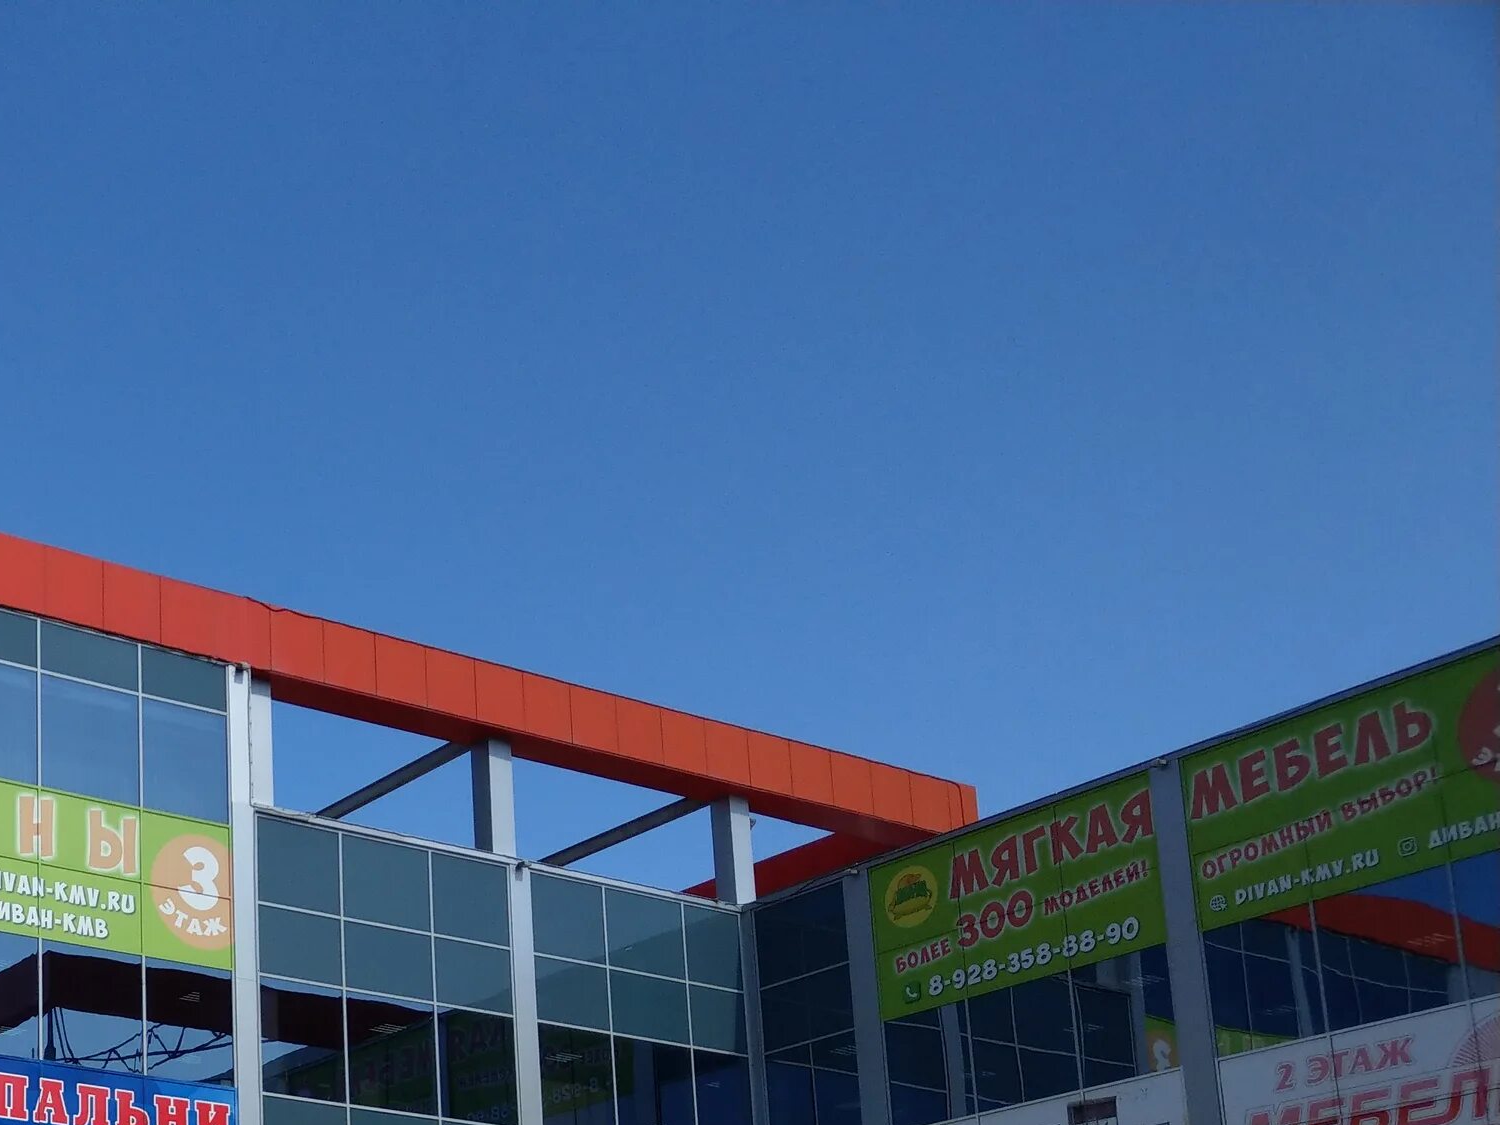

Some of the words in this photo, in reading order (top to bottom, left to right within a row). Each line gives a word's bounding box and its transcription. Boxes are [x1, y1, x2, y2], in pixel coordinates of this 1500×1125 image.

[1190, 701, 1433, 820] МЕБЕЛЬ
[949, 789, 1154, 899] МЯГКАЯ
[1201, 810, 1333, 880] ОГРОМНЫЙ
[1340, 766, 1438, 822] ВЫБОР!
[182, 846, 220, 910] 3
[1235, 848, 1381, 905] DIVAN-KMV.RU
[158, 897, 228, 947] ЭТАЖ
[895, 937, 951, 975] БОЛЕЕ
[957, 889, 1033, 948] 300
[1044, 859, 1150, 916] МОДЕЛЕЙ!
[928, 917, 1140, 997] 8-928-358-88-90
[1275, 1061, 1296, 1092] 2
[1305, 1036, 1413, 1086] ЭТАЖ
